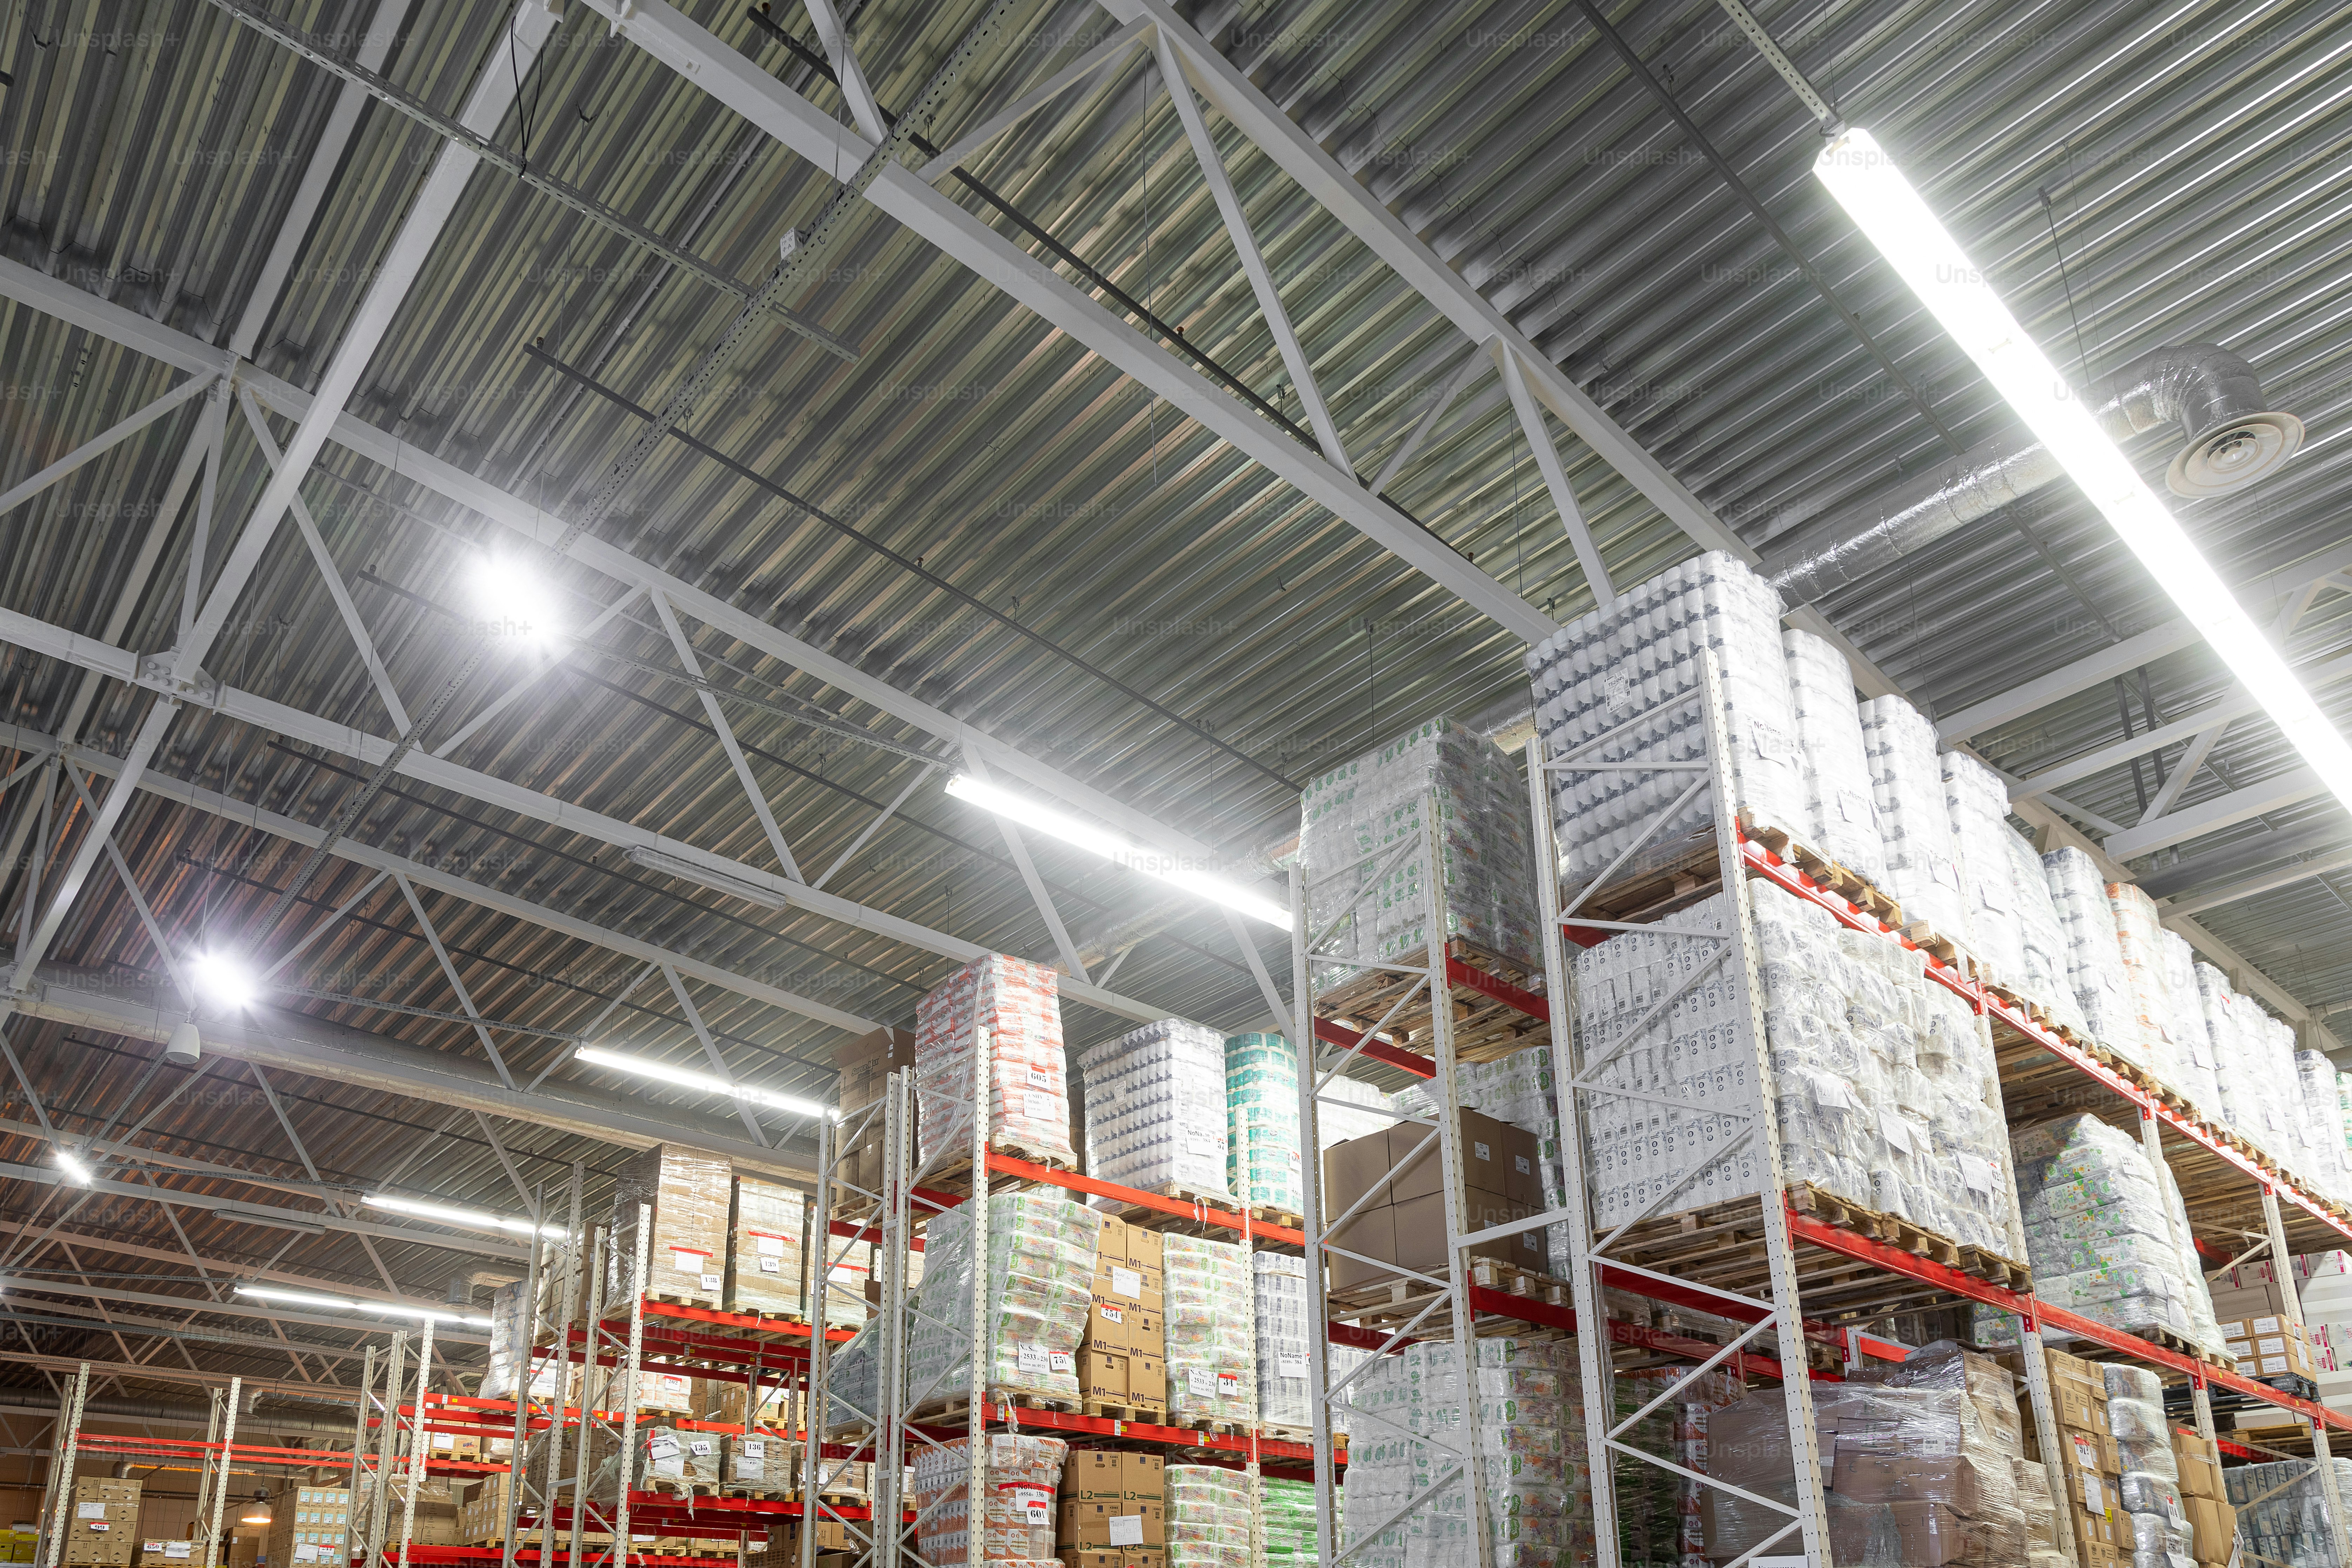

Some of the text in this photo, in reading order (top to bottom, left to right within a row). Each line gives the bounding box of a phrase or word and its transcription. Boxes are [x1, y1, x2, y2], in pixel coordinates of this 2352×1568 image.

[1031, 1072, 1046, 1082] 605
[1098, 1251, 1102, 1260] 1
[1129, 1257, 1141, 1269] M1
[1092, 1294, 1105, 1305] M1
[1129, 1302, 1141, 1313] M1
[1105, 1309, 1118, 1318] 754
[1094, 1339, 1106, 1350] M1
[1130, 1347, 1142, 1357] M1
[1224, 1377, 1233, 1387] 34
[1093, 1386, 1105, 1396] M1
[1132, 1392, 1144, 1402] M1
[1081, 1490, 1093, 1500] L2
[1124, 1490, 1136, 1501] L2
[1031, 1510, 1045, 1518] 601
[1079, 1541, 1092, 1551] L2
